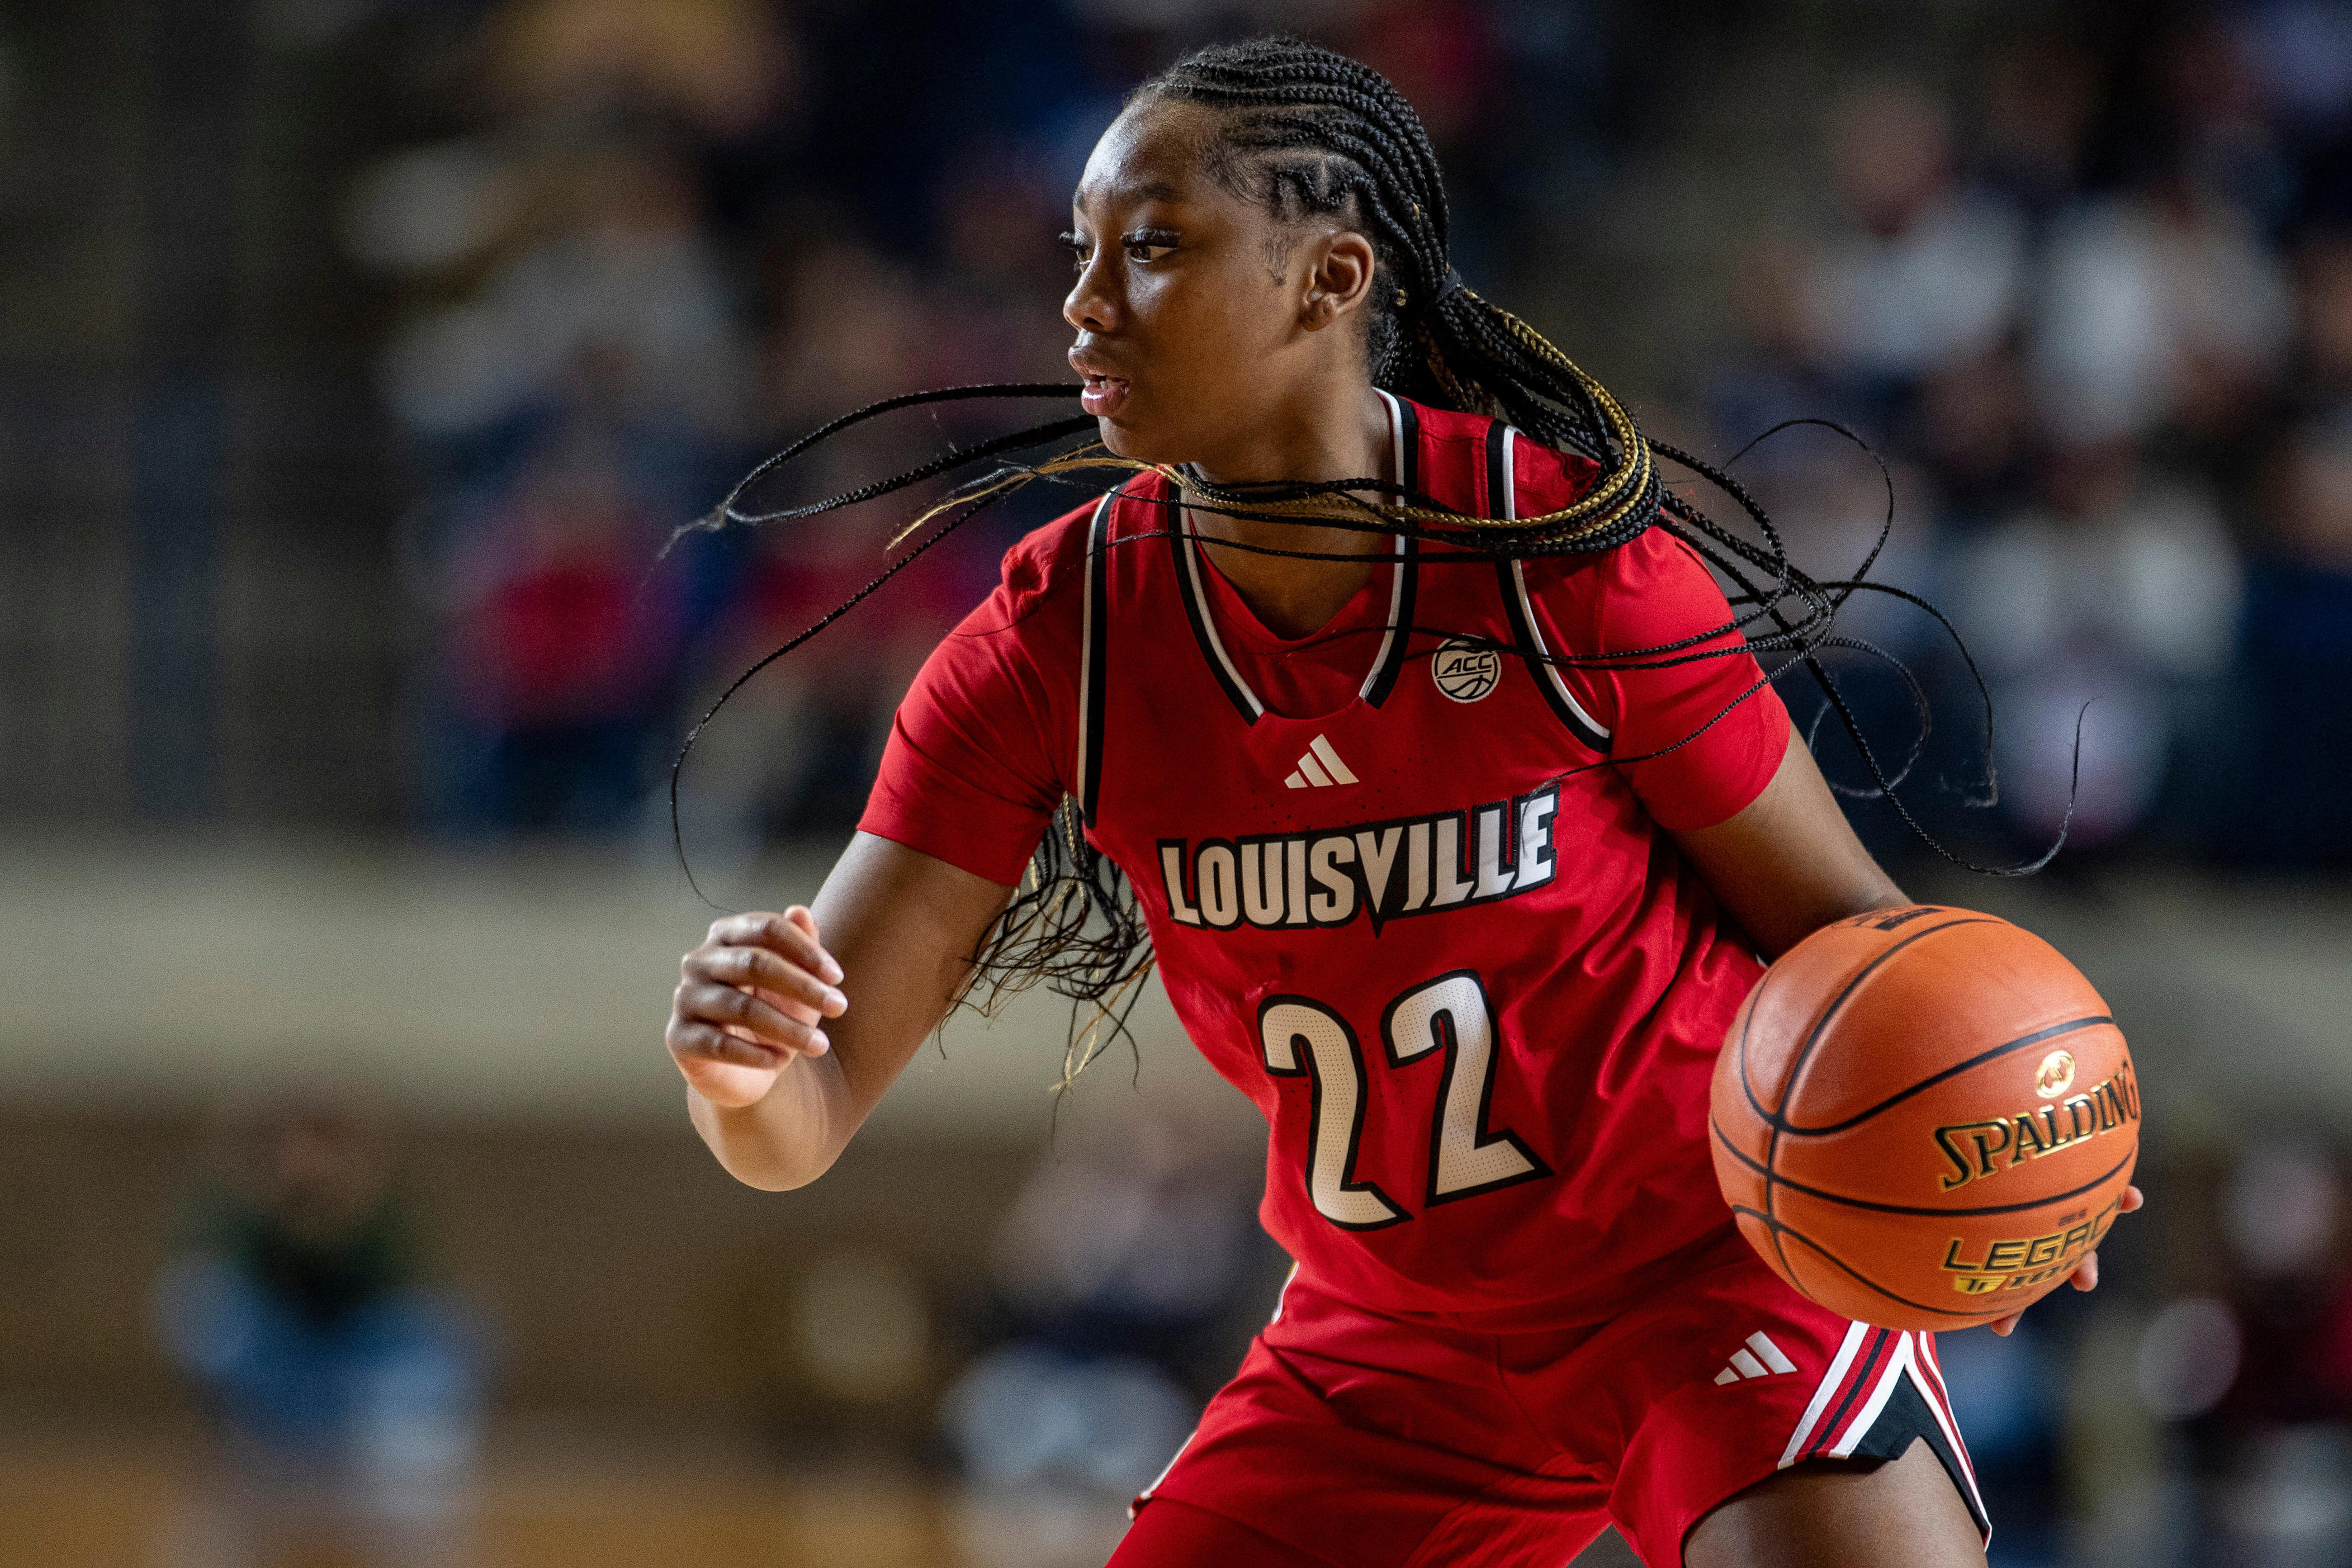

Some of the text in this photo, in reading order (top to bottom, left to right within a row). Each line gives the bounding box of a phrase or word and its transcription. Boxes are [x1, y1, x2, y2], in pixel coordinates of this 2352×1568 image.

[1441, 652, 1494, 675] ACC
[1157, 784, 1561, 939] LOUISVILLE
[1257, 968, 1555, 1231] 22
[1934, 1058, 2140, 1193] SPALDING
